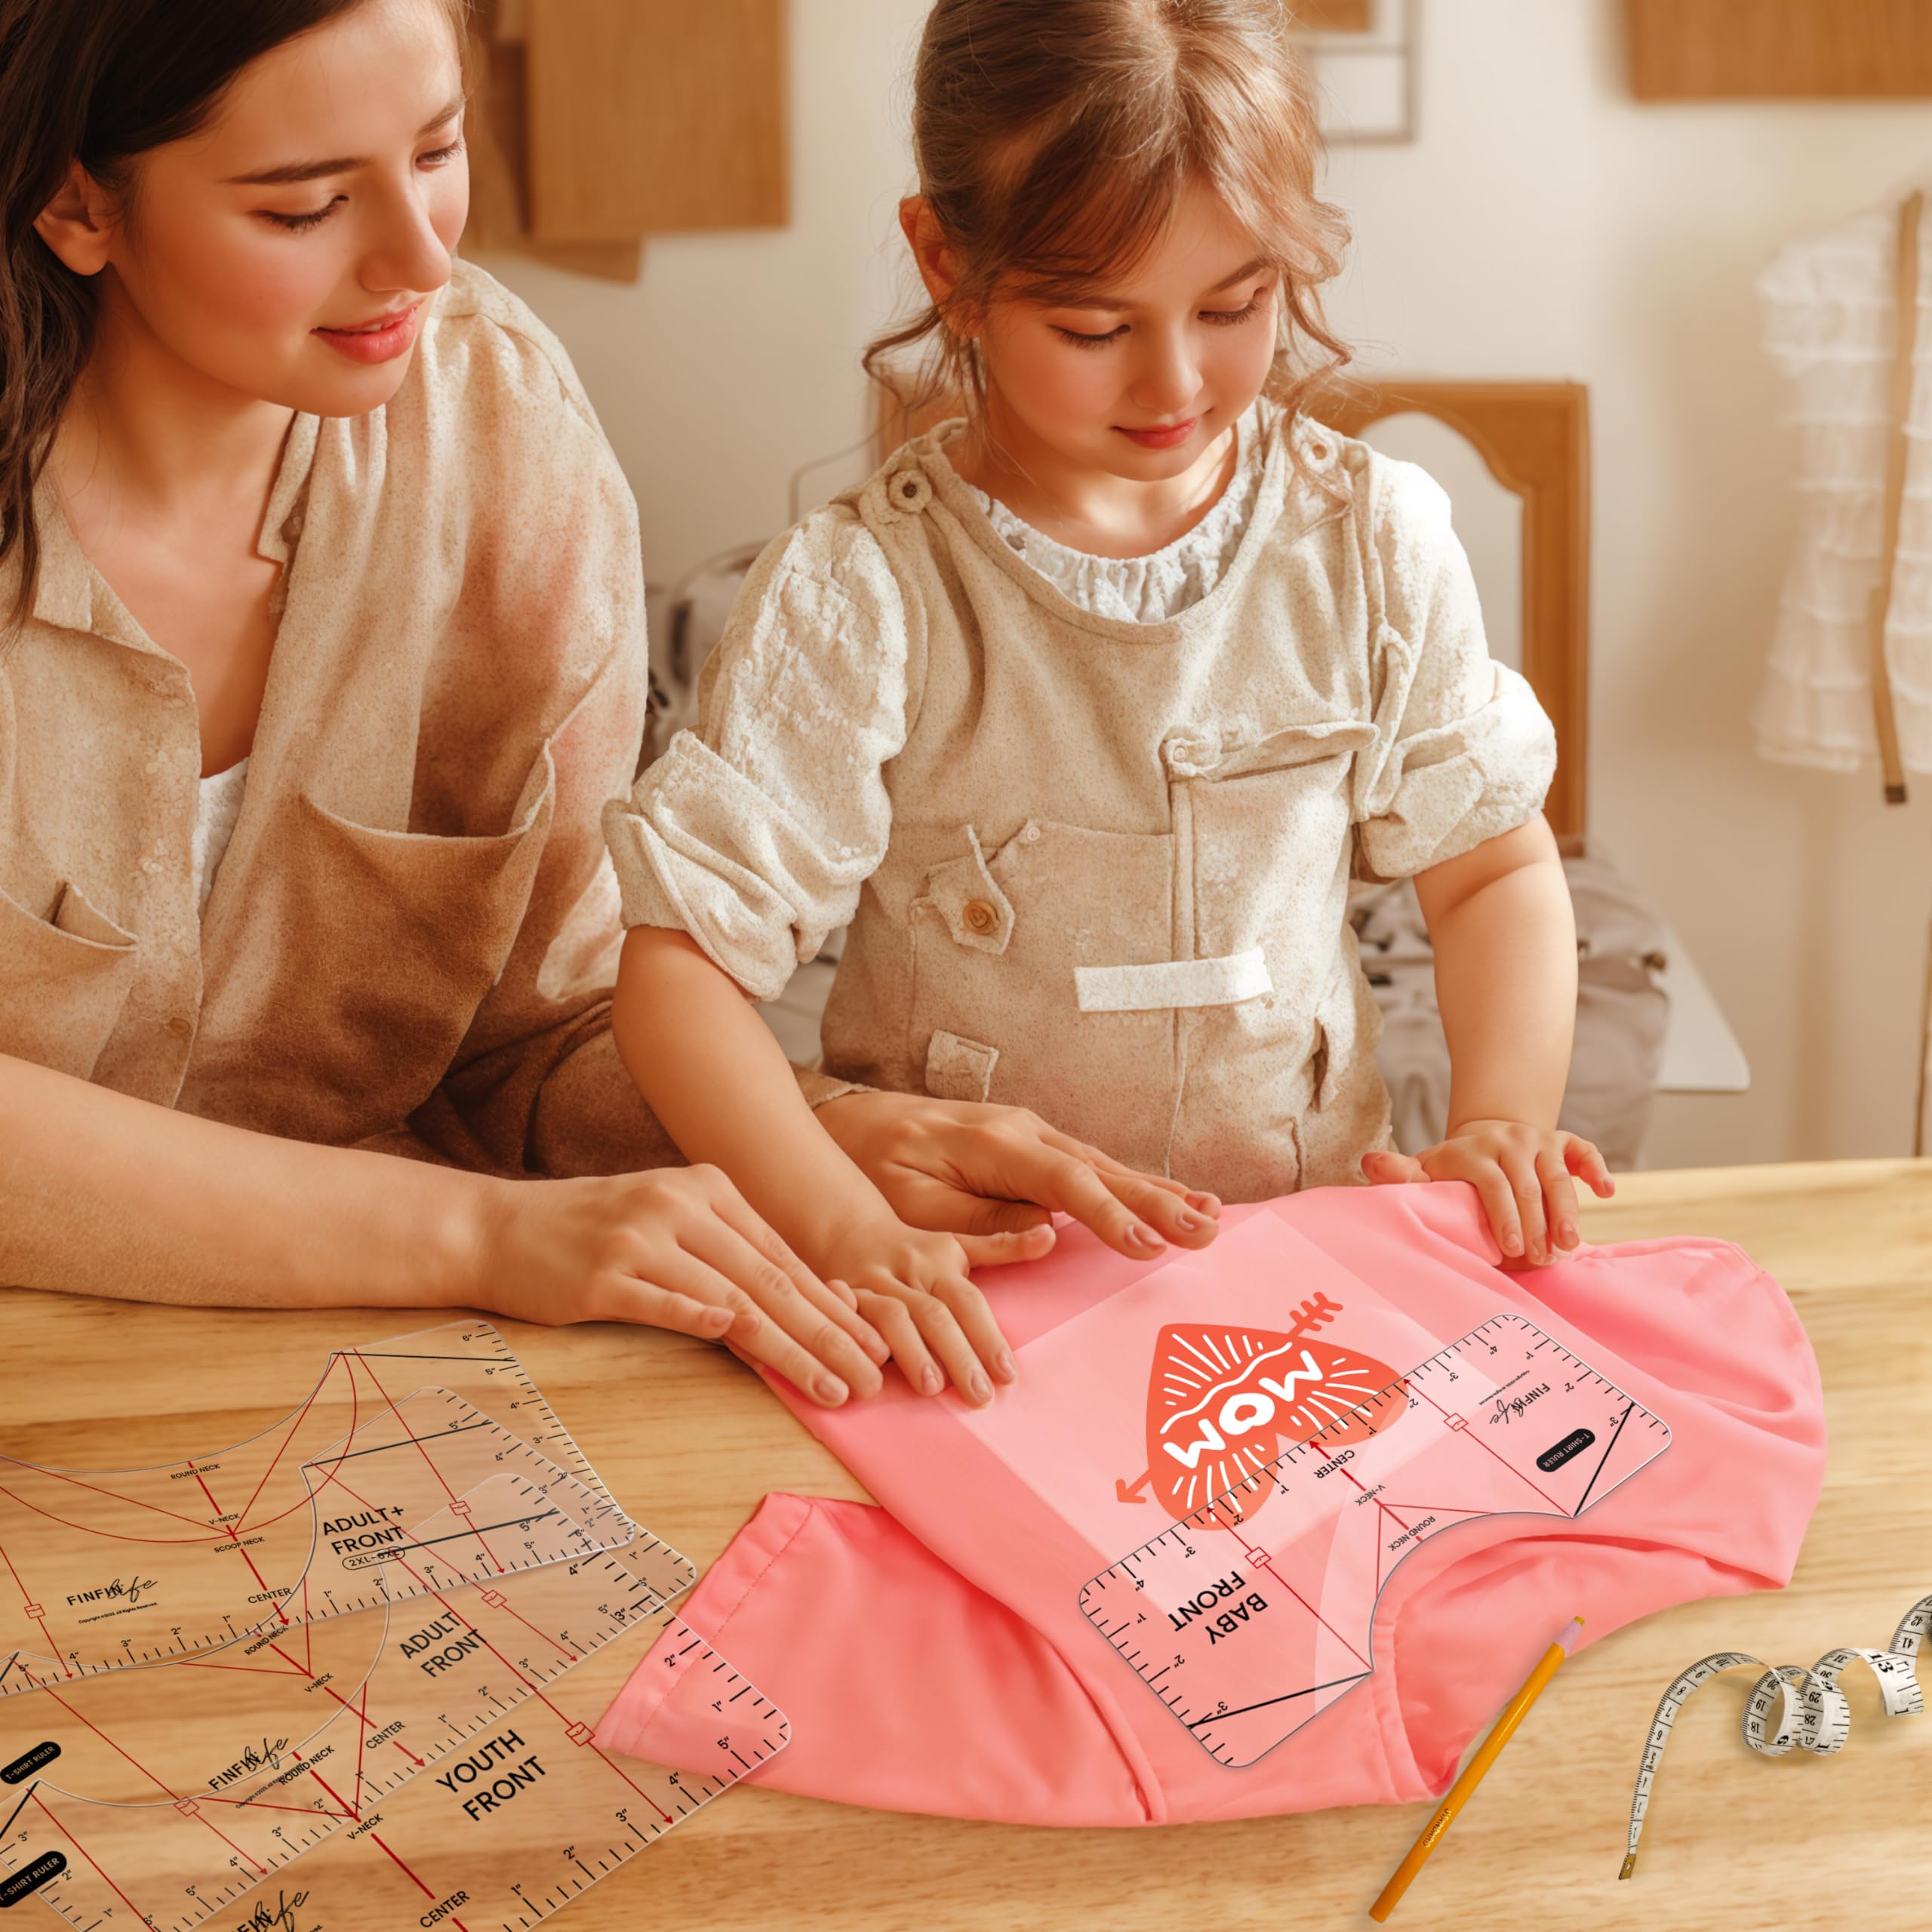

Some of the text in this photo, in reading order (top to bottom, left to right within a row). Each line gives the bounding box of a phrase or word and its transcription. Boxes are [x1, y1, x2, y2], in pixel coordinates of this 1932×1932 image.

[1313, 1449, 1355, 1479] CENTER
[1543, 1433, 1591, 1468] T-SHIRT RULER
[171, 1463, 221, 1480] ROUND NECK
[1354, 1484, 1386, 1507] V-NECK
[208, 1513, 240, 1525] V-NECK
[1387, 1515, 1436, 1552] ROUND NECK
[214, 1537, 265, 1553] SCOOP NECK
[331, 1526, 404, 1555] FRONT
[248, 1587, 293, 1604] CENTER
[1168, 1570, 1246, 1632] FRONT
[1205, 1592, 1269, 1645] BABY
[244, 1625, 289, 1656] ROUND NECK
[399, 1611, 462, 1659] ADULT
[1902, 1637, 1914, 1648] 41
[420, 1629, 487, 1678] FRONT
[304, 1672, 334, 1693] V-NECK
[1677, 1686, 1686, 1695] 8
[1755, 1701, 1766, 1712] 19
[365, 1720, 406, 1750] CENTER
[1751, 1721, 1760, 1734] 18
[5, 1746, 55, 1780] T-SHIRT RULER
[278, 1761, 311, 1786] ROUND
[309, 1745, 335, 1766] NECK
[435, 1728, 526, 1793] YOUTH
[462, 1755, 546, 1822] FRONT
[346, 1813, 383, 1841] V-NECK
[32, 1857, 60, 1878] RULER
[420, 1890, 470, 1930] CENTER
